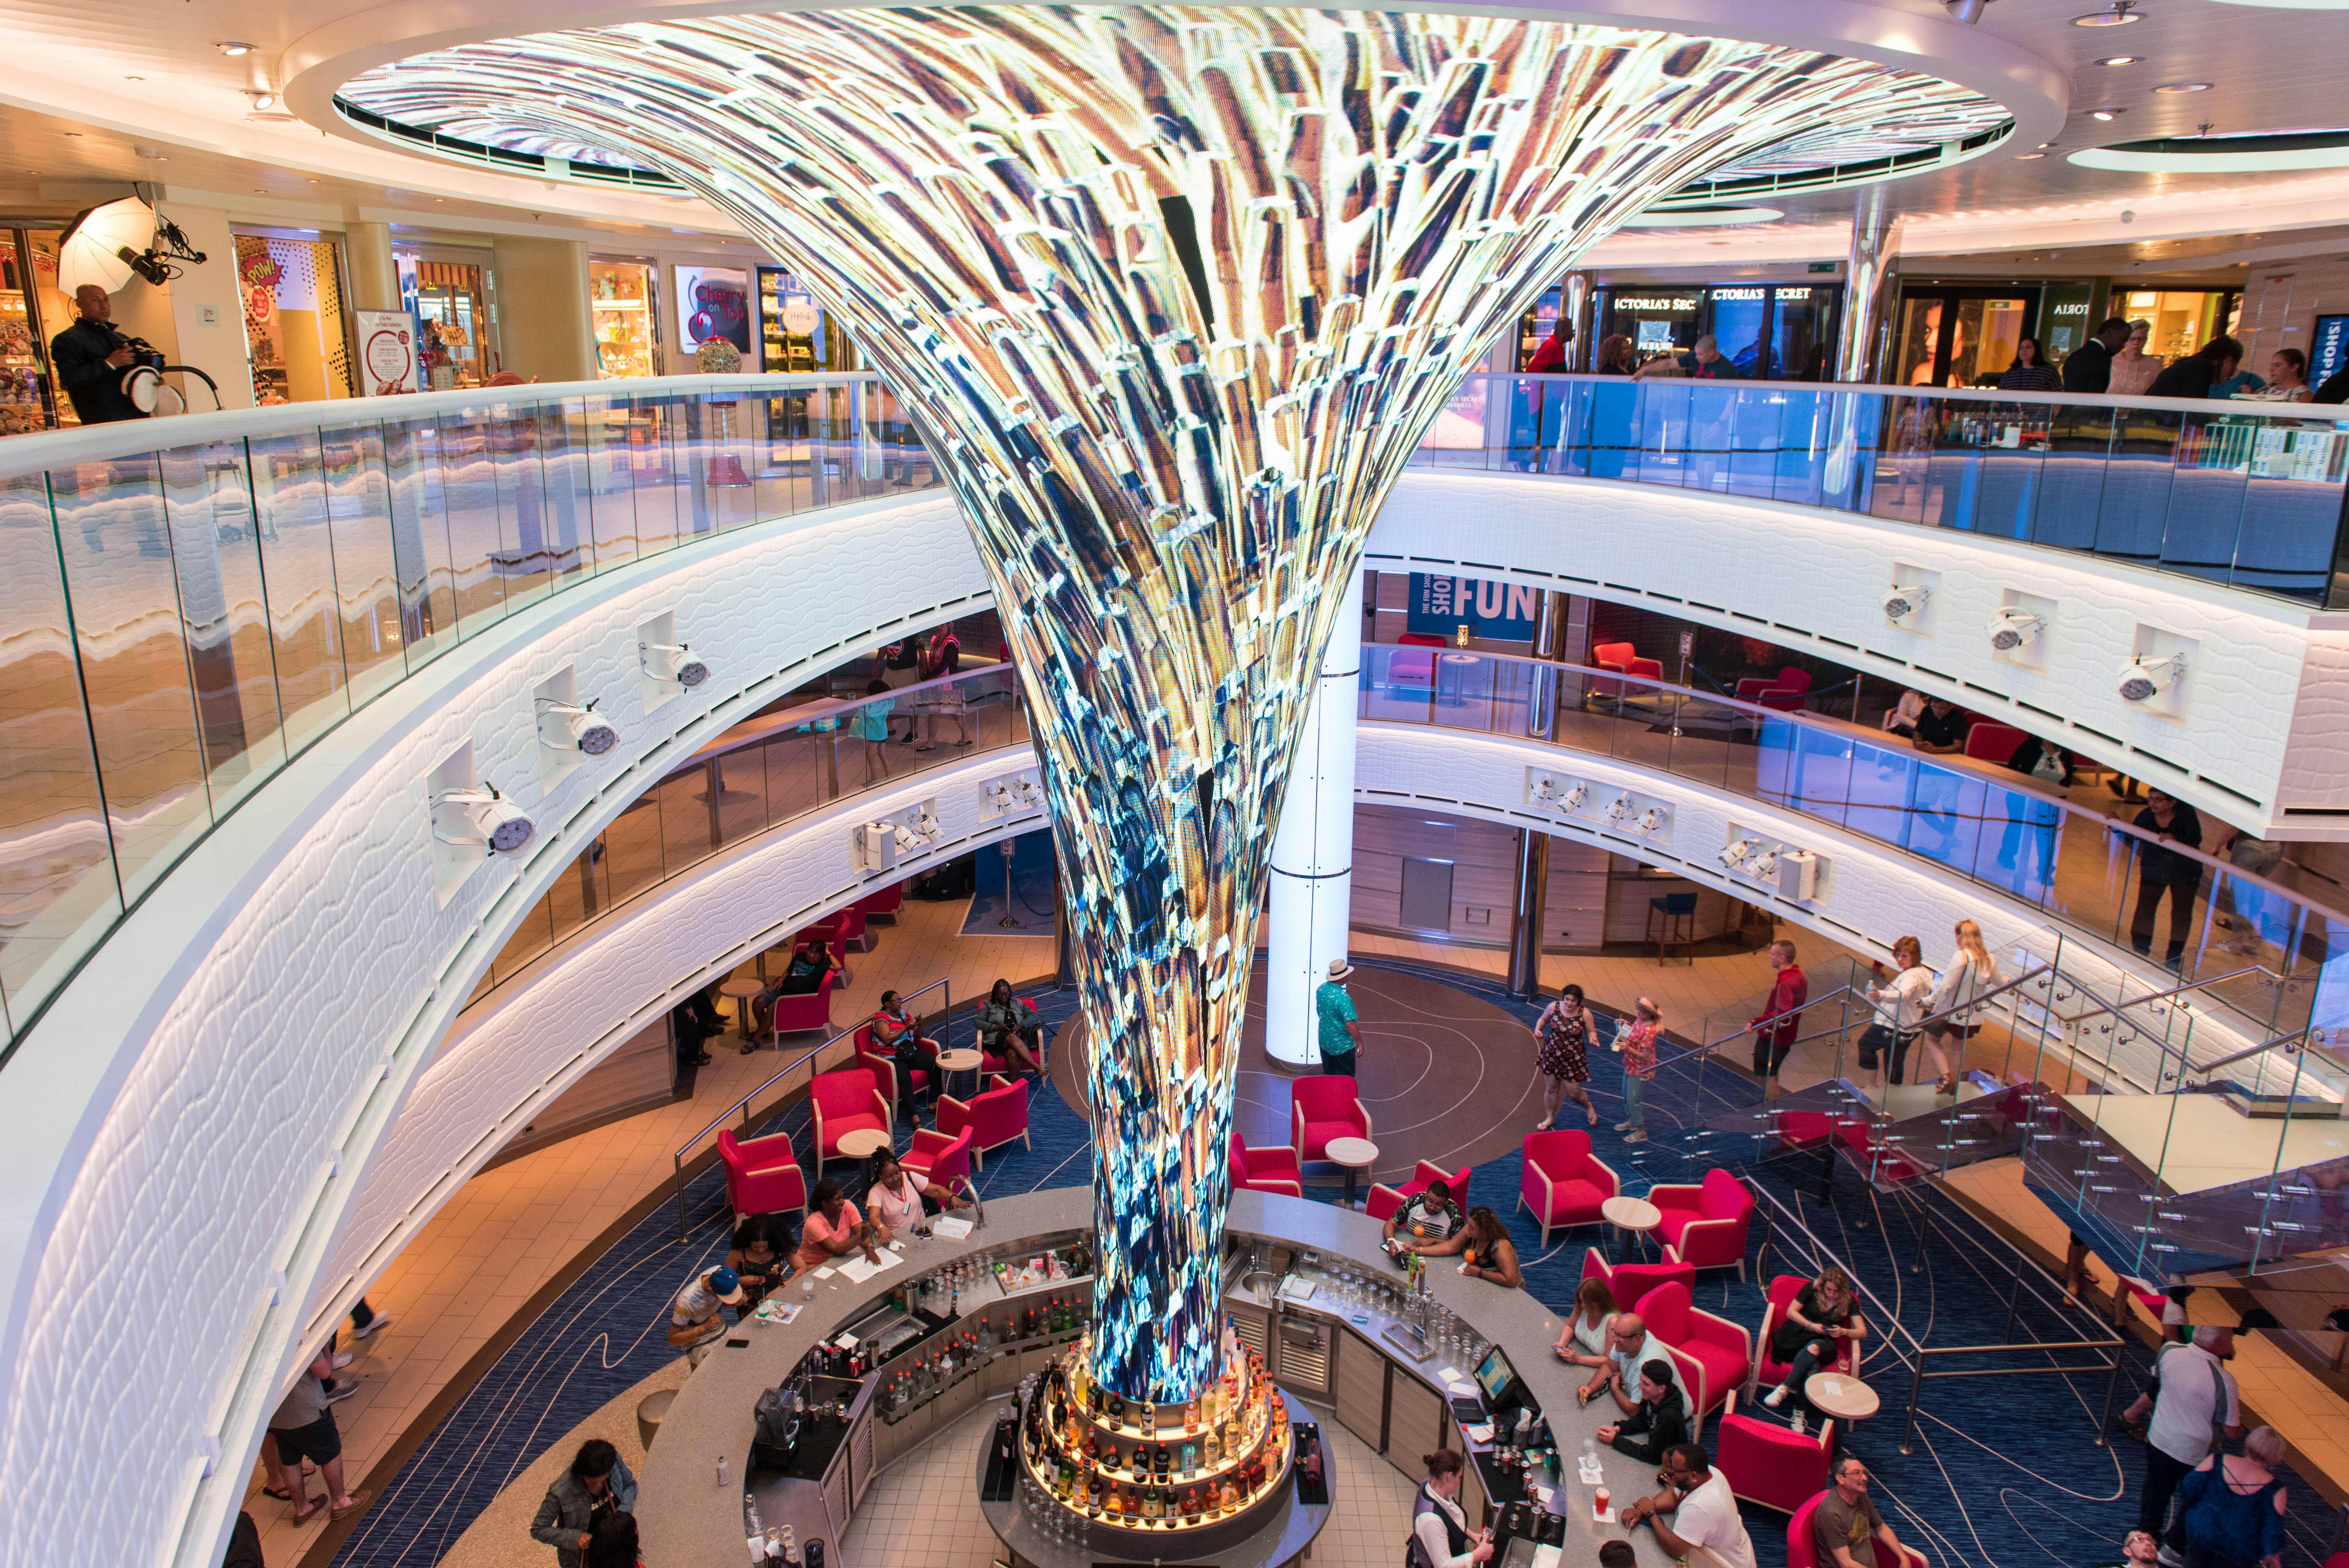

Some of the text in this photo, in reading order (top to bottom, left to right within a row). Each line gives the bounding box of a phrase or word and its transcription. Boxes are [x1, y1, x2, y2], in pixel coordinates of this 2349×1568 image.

[247, 258, 275, 285] POW!
[695, 285, 745, 306] Cherry
[1672, 298, 1697, 310] SEC
[1711, 288, 1764, 300] CTORIA'S
[708, 304, 745, 323] on Top
[1454, 577, 1537, 622] FUN
